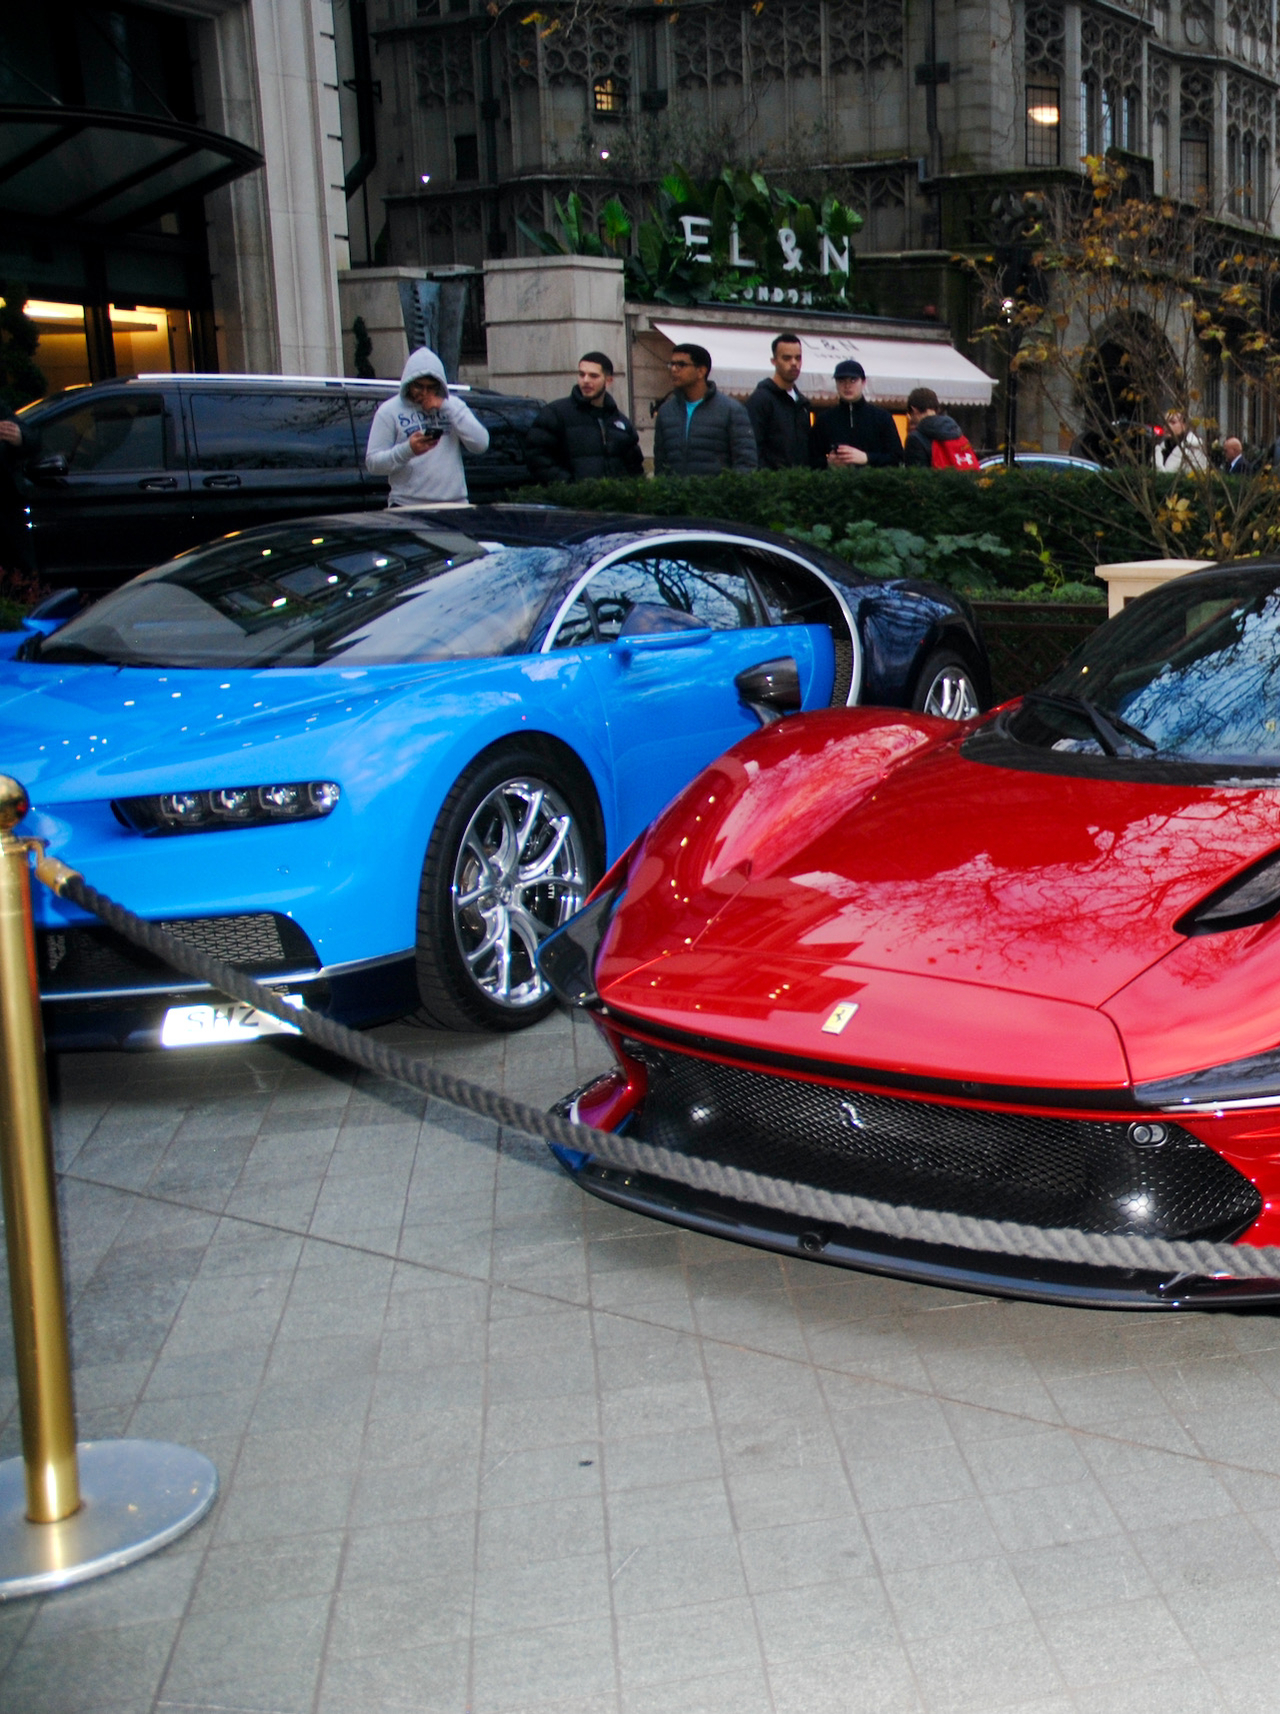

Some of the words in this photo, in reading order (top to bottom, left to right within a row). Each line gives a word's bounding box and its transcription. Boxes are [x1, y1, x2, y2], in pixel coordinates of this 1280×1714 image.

[679, 215, 756, 267] EL
[777, 227, 803, 273] &
[819, 233, 849, 278] N
